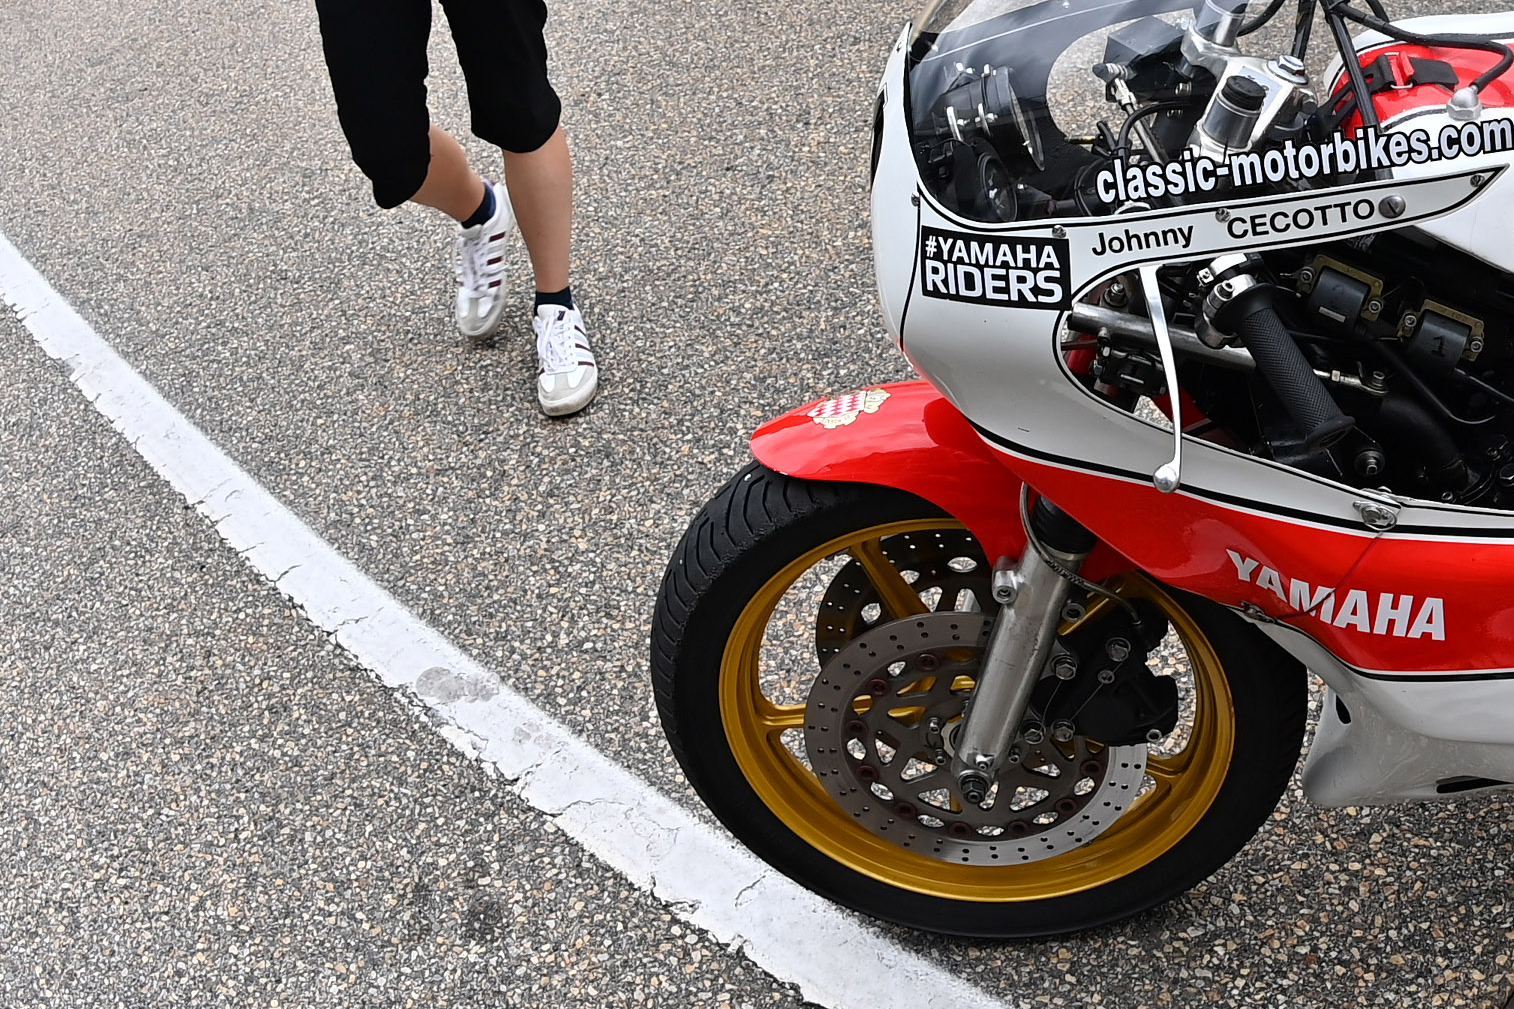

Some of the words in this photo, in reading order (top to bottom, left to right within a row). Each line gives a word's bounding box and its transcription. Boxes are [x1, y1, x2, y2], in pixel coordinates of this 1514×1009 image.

[925, 235, 1060, 269] #YAMAHA
[1092, 225, 1194, 257] Johnny
[1227, 197, 1375, 241] CECOTTO
[925, 259, 1063, 303] RIDERS
[1225, 548, 1445, 641] YAMAHA
